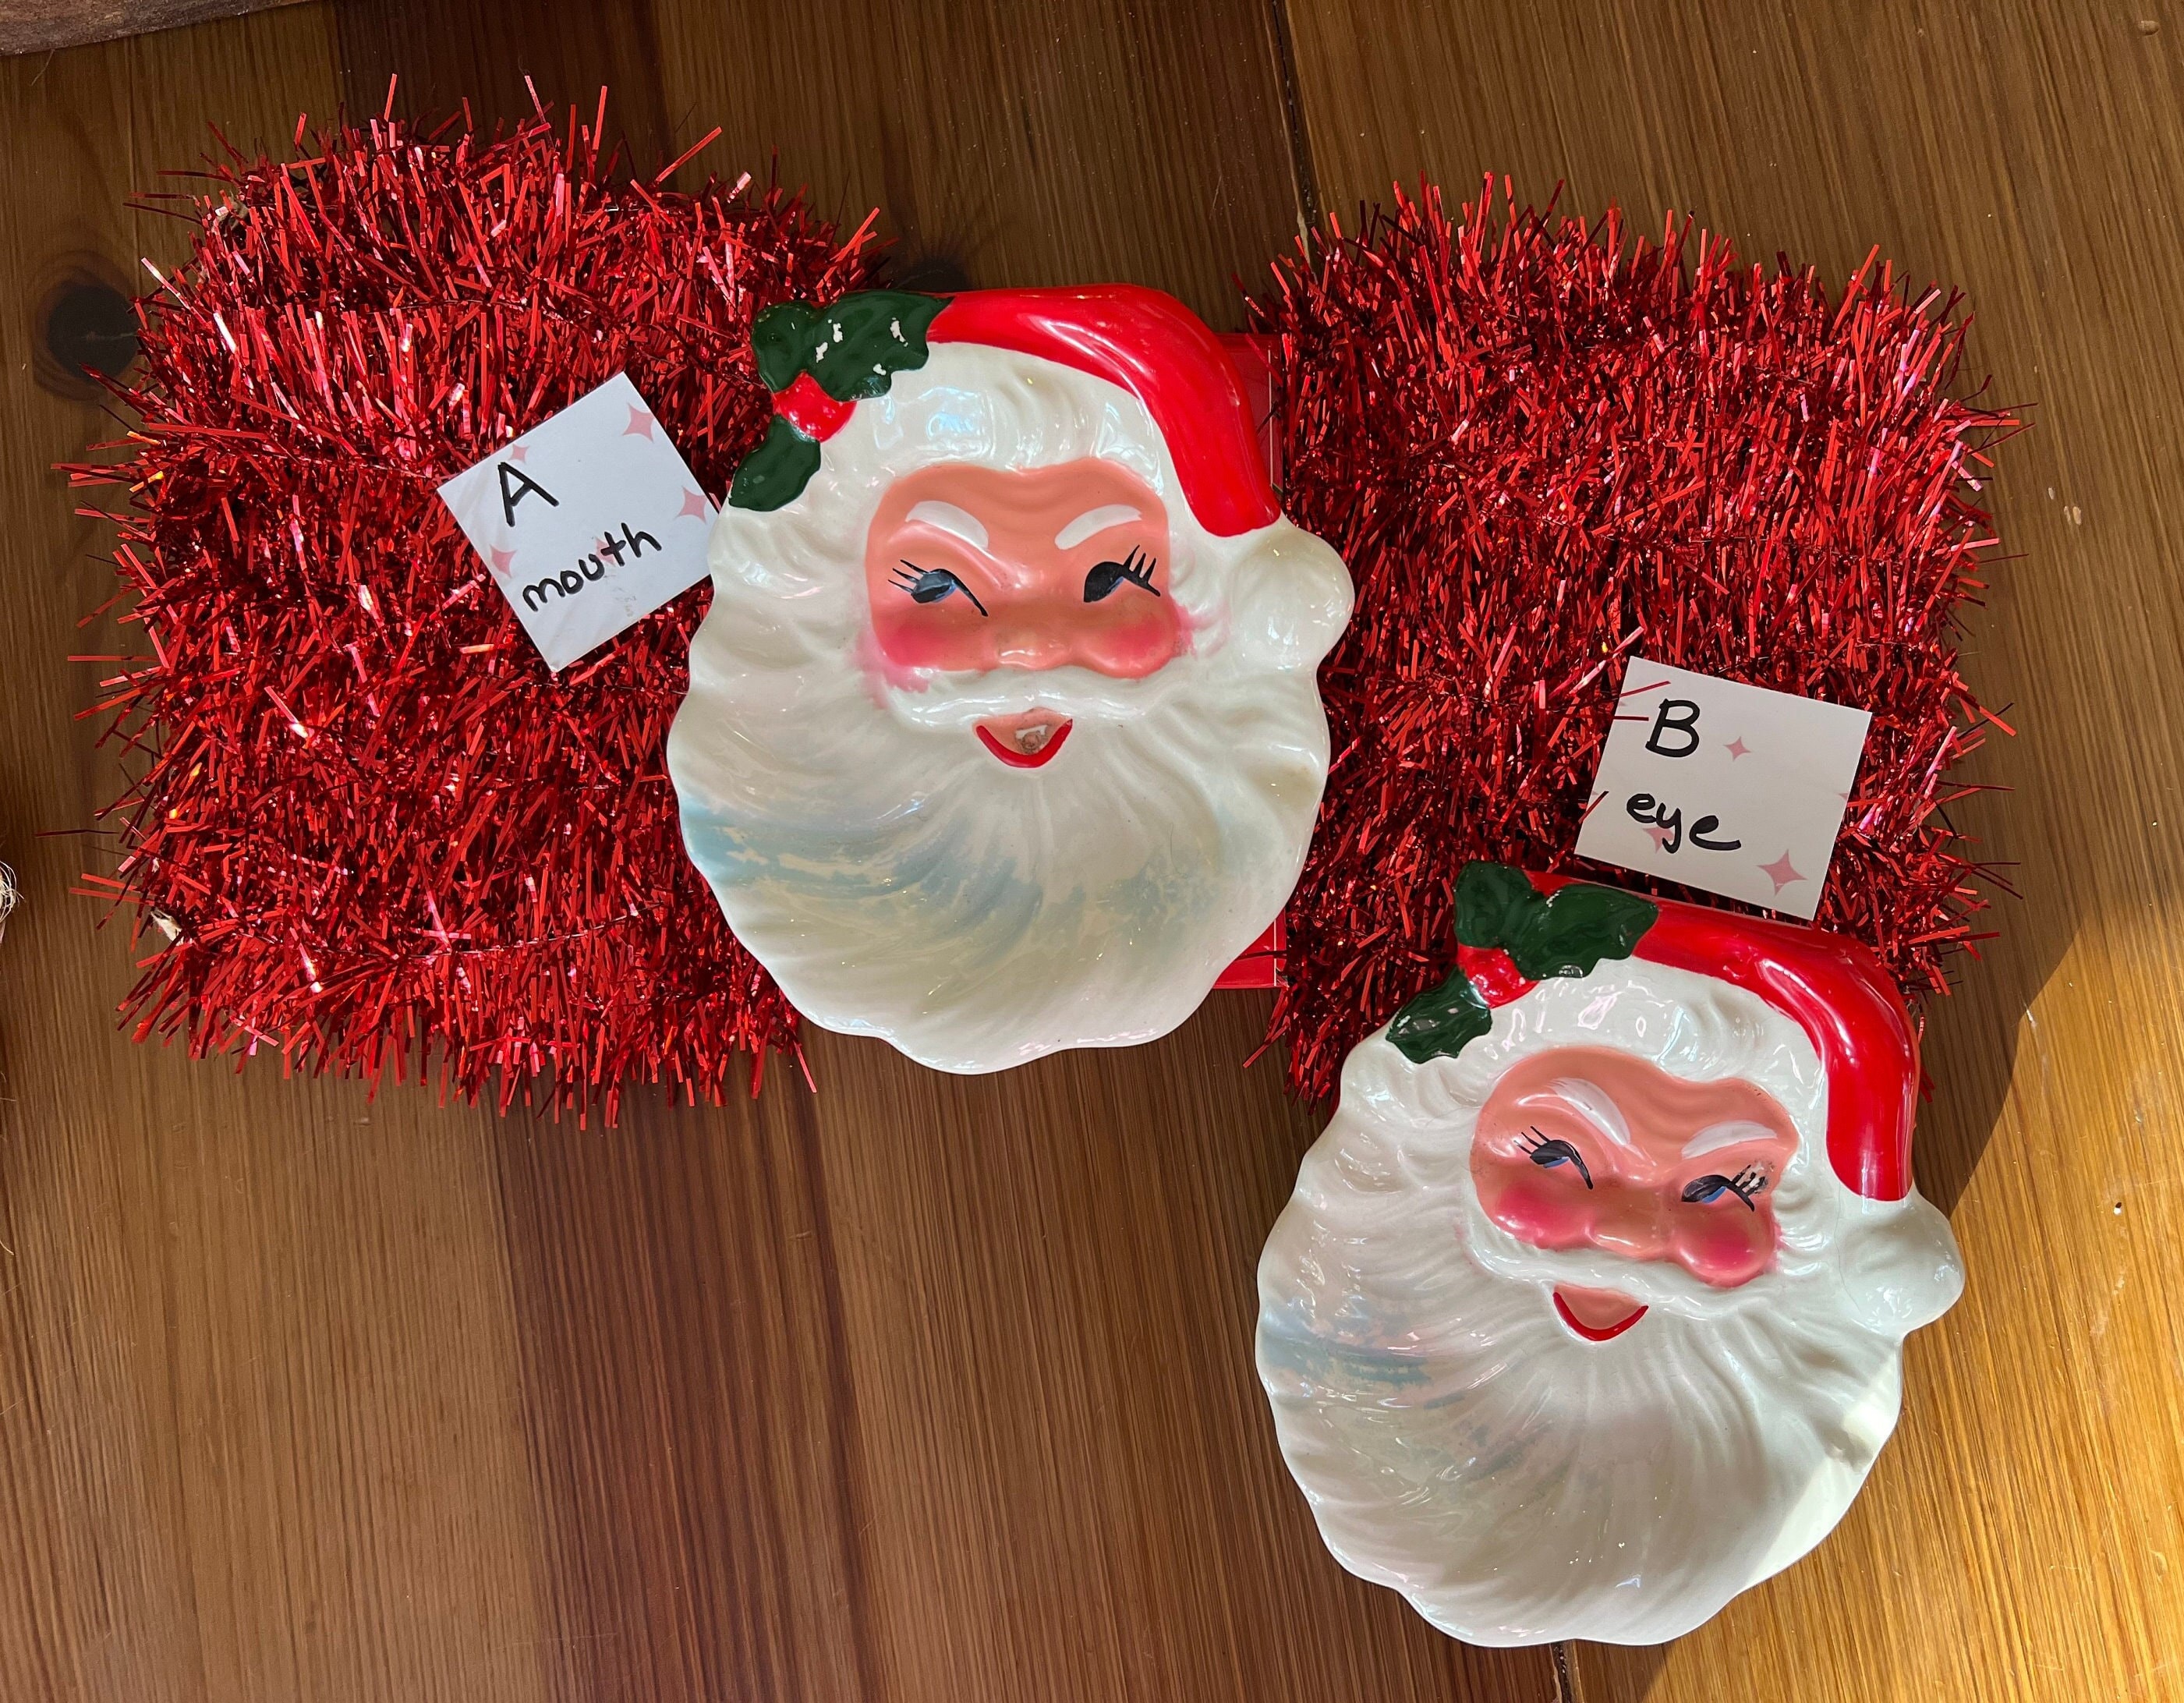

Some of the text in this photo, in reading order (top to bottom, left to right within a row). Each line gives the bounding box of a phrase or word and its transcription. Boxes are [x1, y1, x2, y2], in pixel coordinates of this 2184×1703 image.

[497, 462, 560, 527] A
[522, 522, 663, 612] mouth
[1644, 698, 1701, 758] B
[1626, 793, 1742, 854] eye
